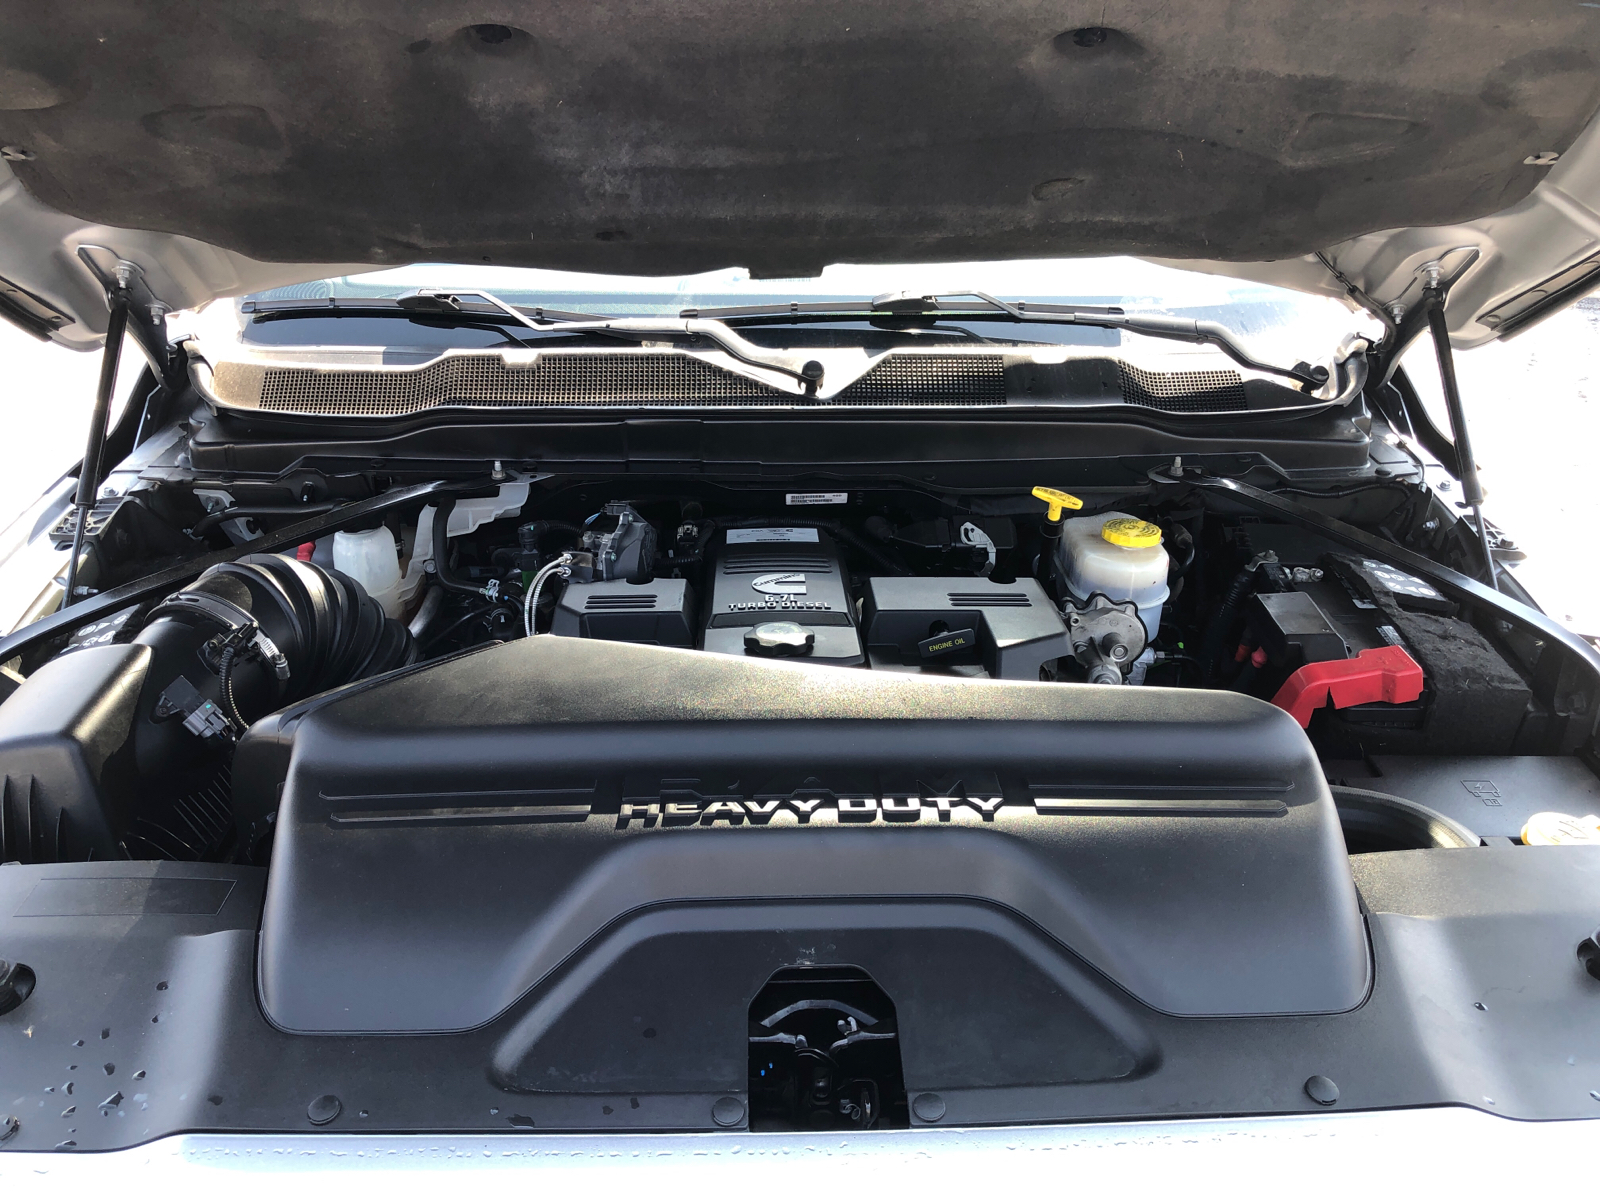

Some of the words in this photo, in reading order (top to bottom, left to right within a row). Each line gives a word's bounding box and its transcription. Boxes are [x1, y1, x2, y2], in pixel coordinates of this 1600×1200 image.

[764, 594, 797, 602] 6.7L
[728, 602, 776, 611] TURBO
[781, 601, 831, 610] DIESEL
[928, 640, 953, 652] ENGINE
[954, 637, 965, 646] OIL
[620, 796, 825, 820] HEAVY
[838, 796, 1004, 820] DUTY
